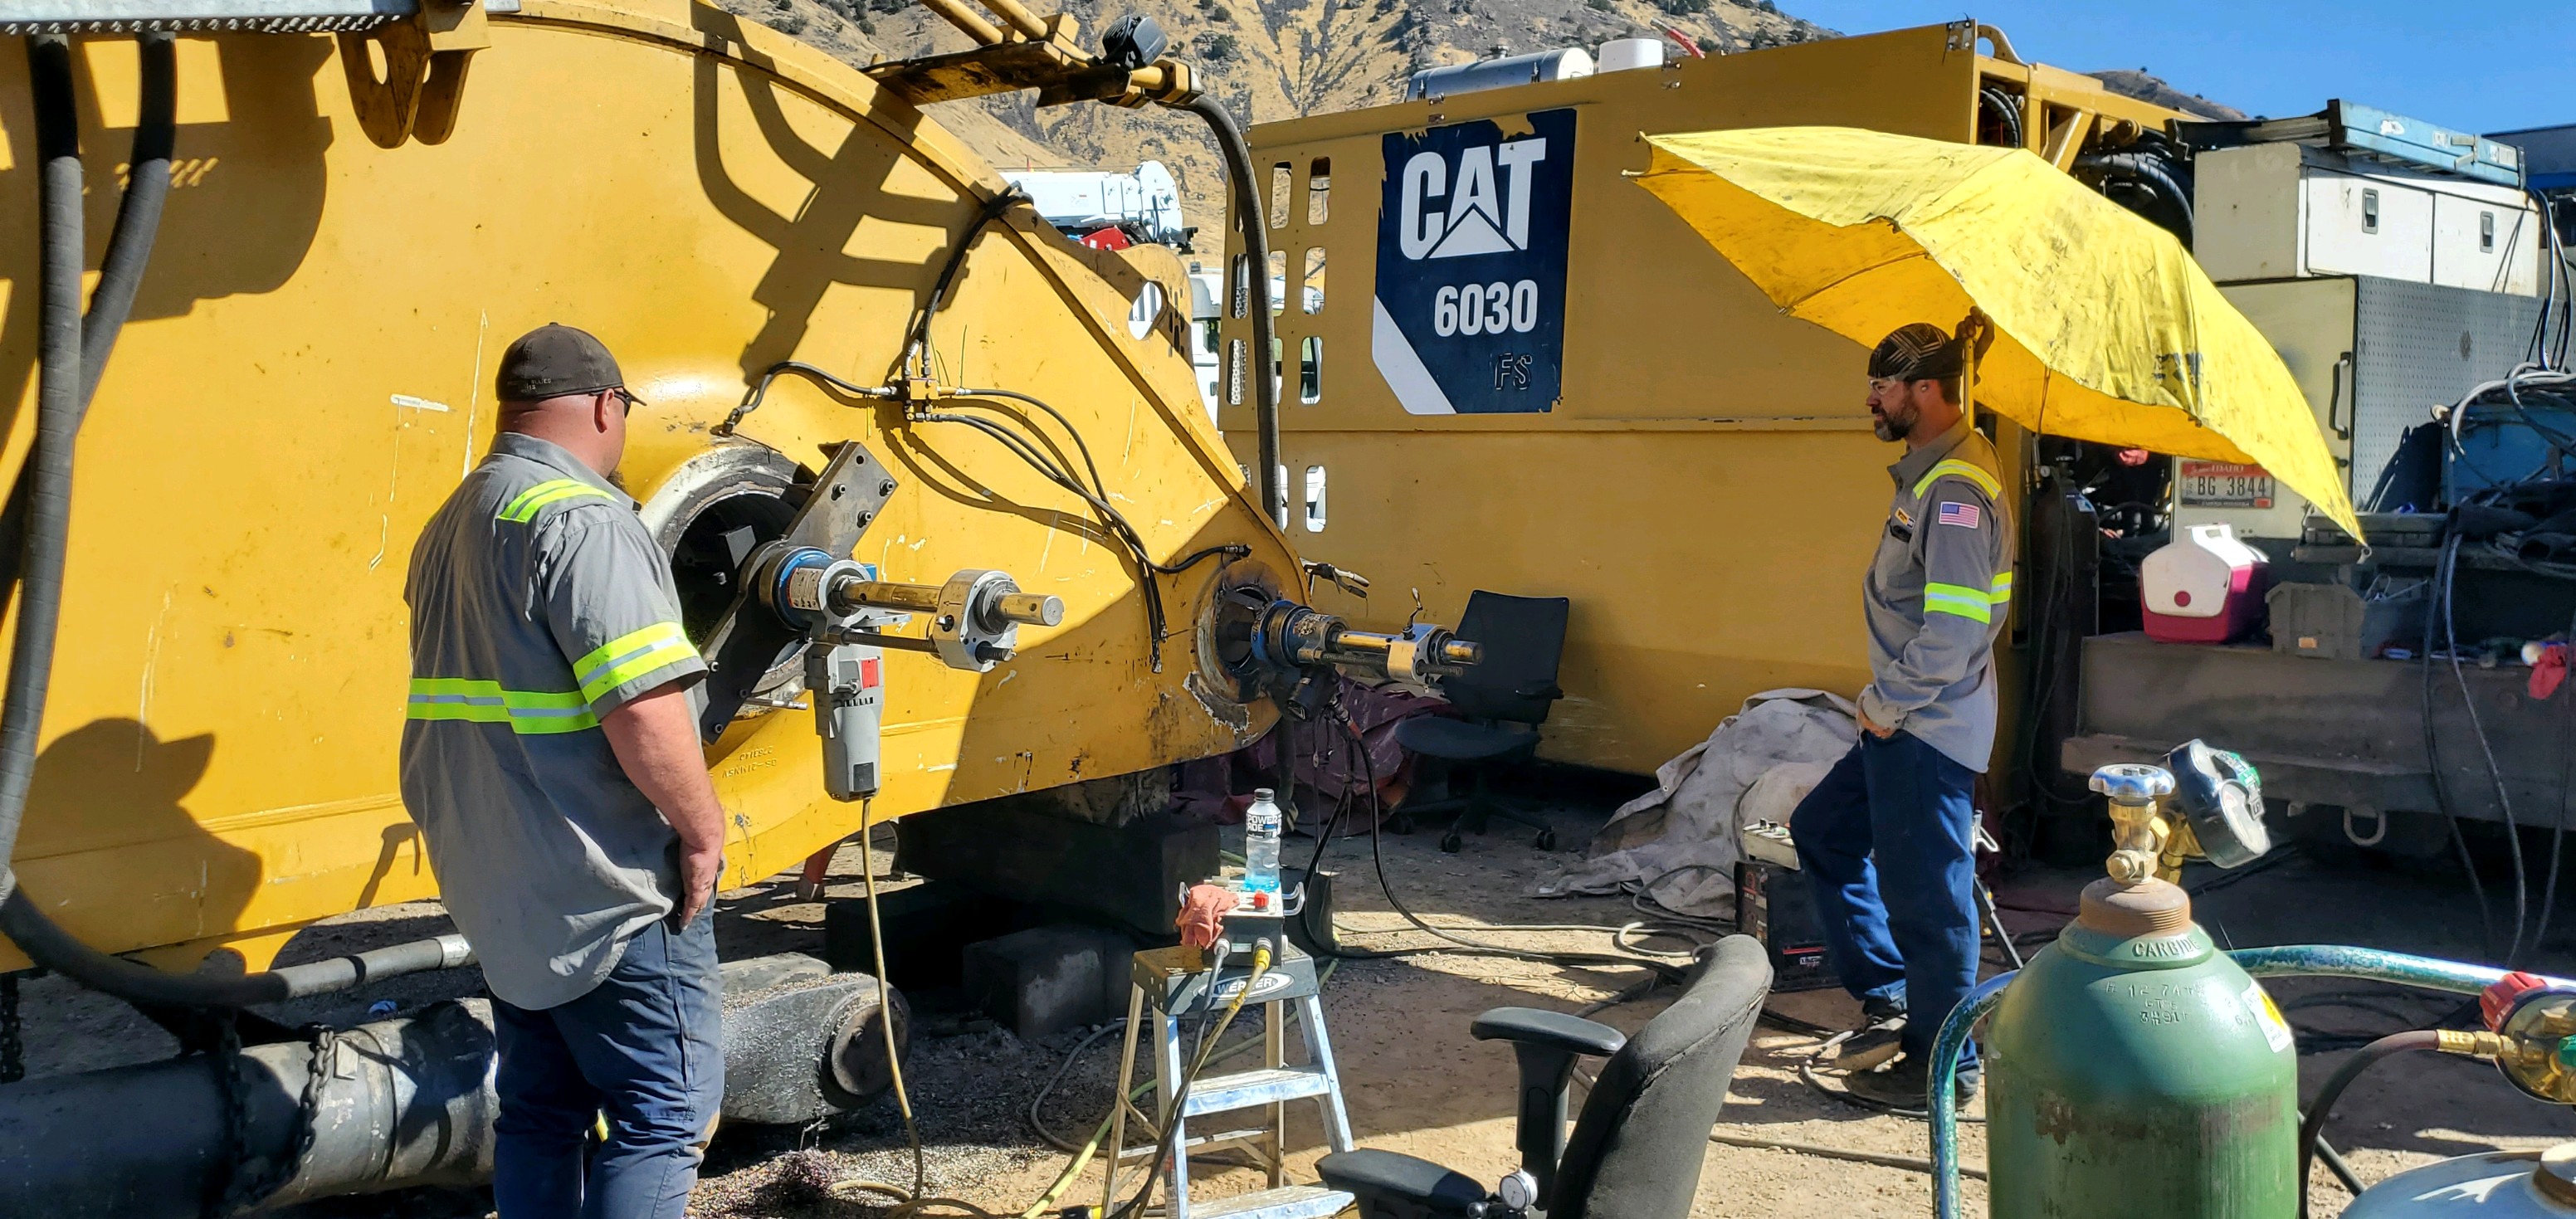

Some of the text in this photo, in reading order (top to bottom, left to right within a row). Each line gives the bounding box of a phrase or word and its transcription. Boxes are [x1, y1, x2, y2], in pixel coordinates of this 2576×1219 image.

[1400, 138, 1547, 261] CAT
[1434, 279, 1539, 338] 6030
[1494, 353, 1534, 391] FS
[2211, 465, 2244, 473] IDAHO
[2198, 475, 2216, 496] BG
[2227, 475, 2266, 496] 3844
[1247, 814, 1278, 825] POWER
[2132, 935, 2201, 958] CARBIDE
[1217, 978, 1273, 994] WERER
